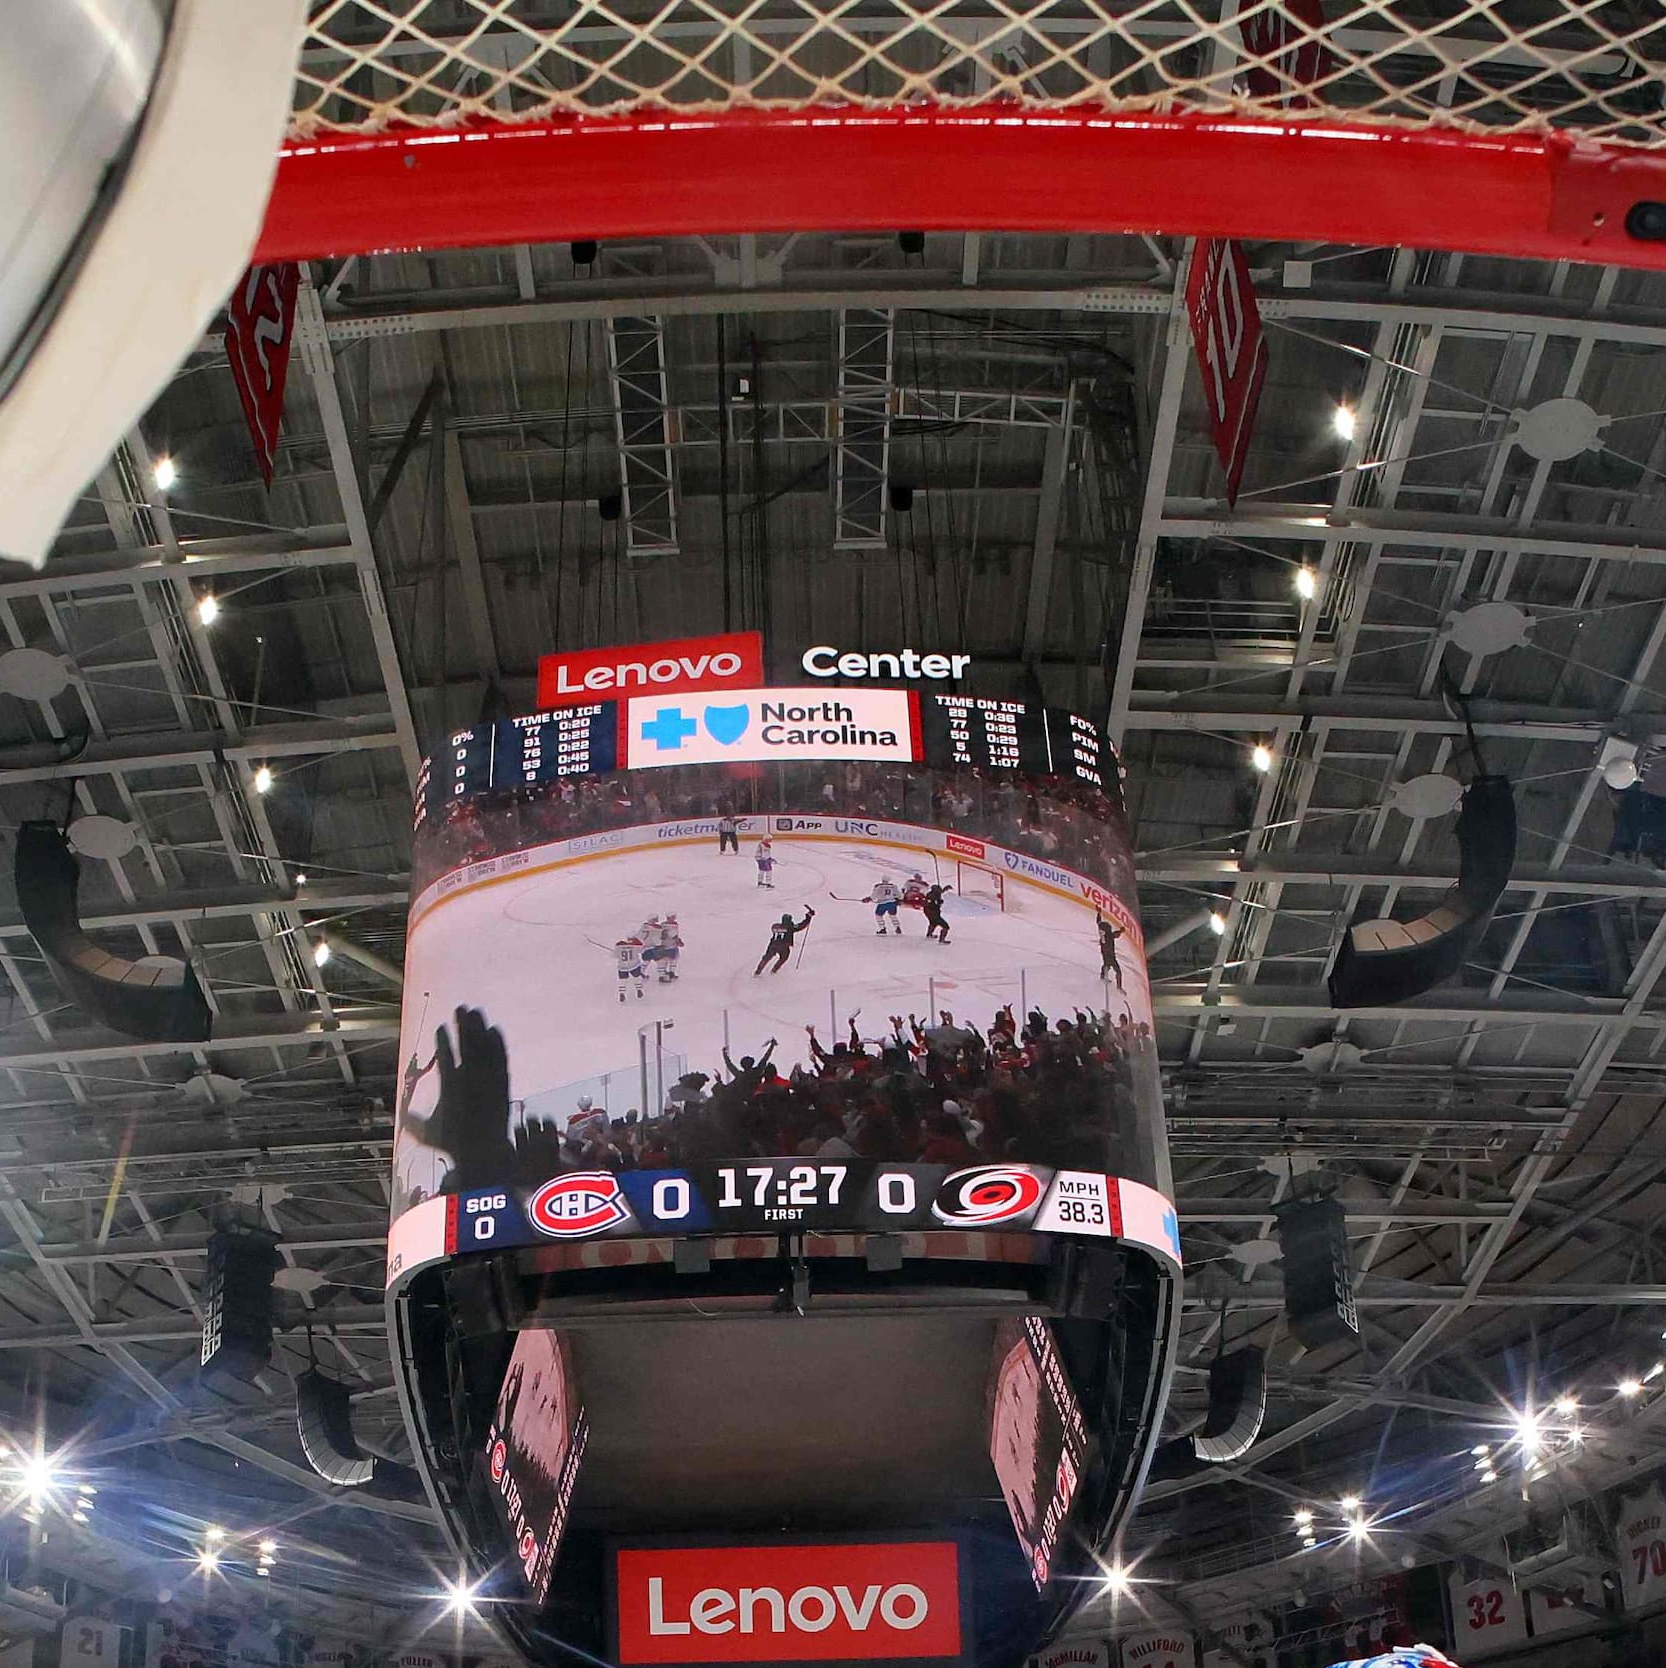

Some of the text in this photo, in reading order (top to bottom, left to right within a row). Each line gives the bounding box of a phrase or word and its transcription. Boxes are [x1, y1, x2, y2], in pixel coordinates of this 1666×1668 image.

[556, 646, 971, 694] Lenovo Center
[761, 702, 853, 723] North
[935, 695, 1026, 714] TIME ON ICE
[512, 705, 602, 728] TIME ON ICE
[525, 718, 590, 737] 77 0:20
[761, 724, 898, 747] Carolina
[950, 719, 1017, 734] 77 0:23
[452, 730, 474, 747] 0%
[524, 729, 590, 748] 91 0:25
[558, 740, 589, 753] 0:22
[950, 730, 1018, 745] 50 0:29
[1071, 731, 1099, 753] PIM
[522, 751, 589, 770] 53 0:45
[952, 753, 1020, 768] 74 1:07
[1073, 748, 1096, 766] SM
[557, 762, 589, 775] 0:40
[1076, 765, 1102, 786] GVA
[835, 820, 878, 836] UNC
[571, 834, 619, 850] SILAC
[949, 838, 983, 856] Lenovo
[1020, 859, 1075, 889] FANDUEL
[718, 1166, 847, 1208] 17:27
[877, 1173, 916, 1214] 0
[1059, 1180, 1100, 1196] MPH
[466, 1194, 507, 1213] SOG
[652, 1178, 690, 1220] 0
[764, 1208, 804, 1221] FIRST
[1059, 1200, 1104, 1225] 38.3
[474, 1216, 495, 1240] 0
[649, 1577, 928, 1636] Lenovo
[1468, 1590, 1506, 1630] 32
